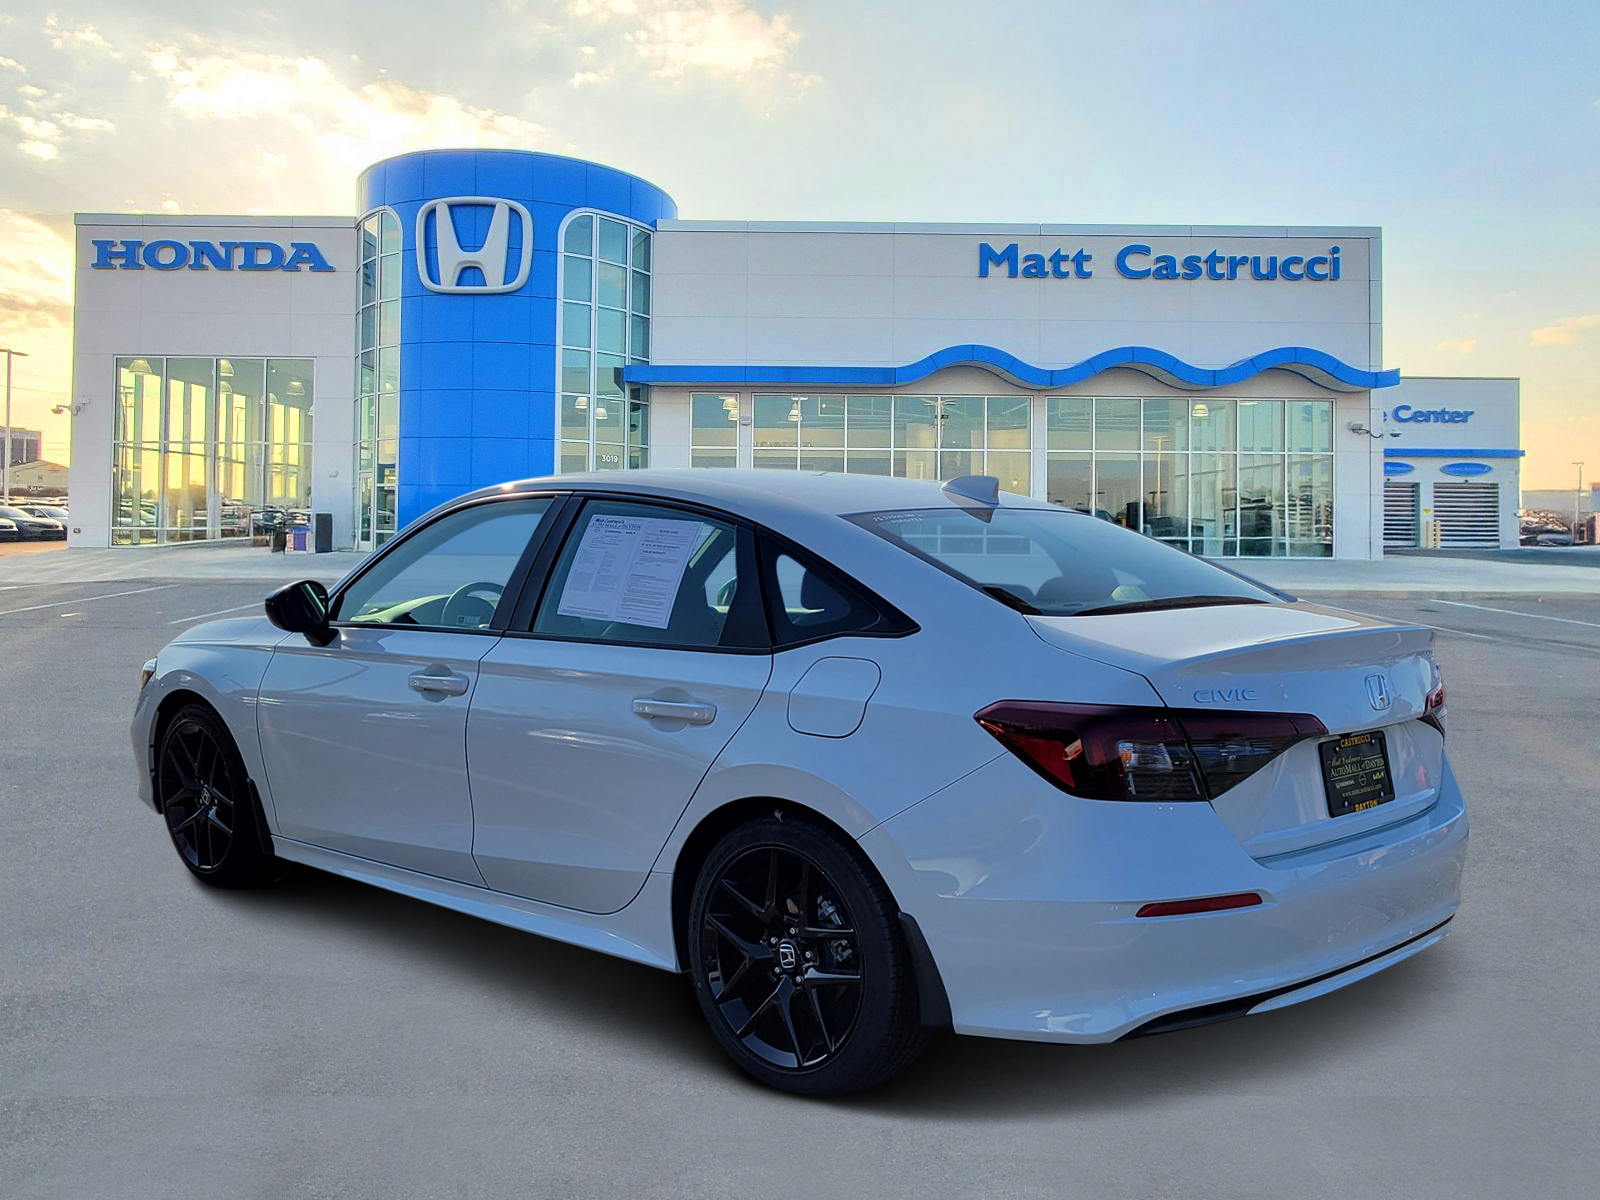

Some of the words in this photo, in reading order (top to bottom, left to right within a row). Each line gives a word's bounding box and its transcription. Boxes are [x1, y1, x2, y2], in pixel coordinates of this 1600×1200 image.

[91, 240, 336, 272] HONDA
[979, 242, 1092, 278] Matt
[1114, 244, 1342, 280] Castrucci
[1392, 404, 1475, 424] Center
[1193, 688, 1258, 703] CIVIC
[1340, 734, 1370, 747] CASTRUCCI
[1355, 799, 1377, 811] DAYTON
